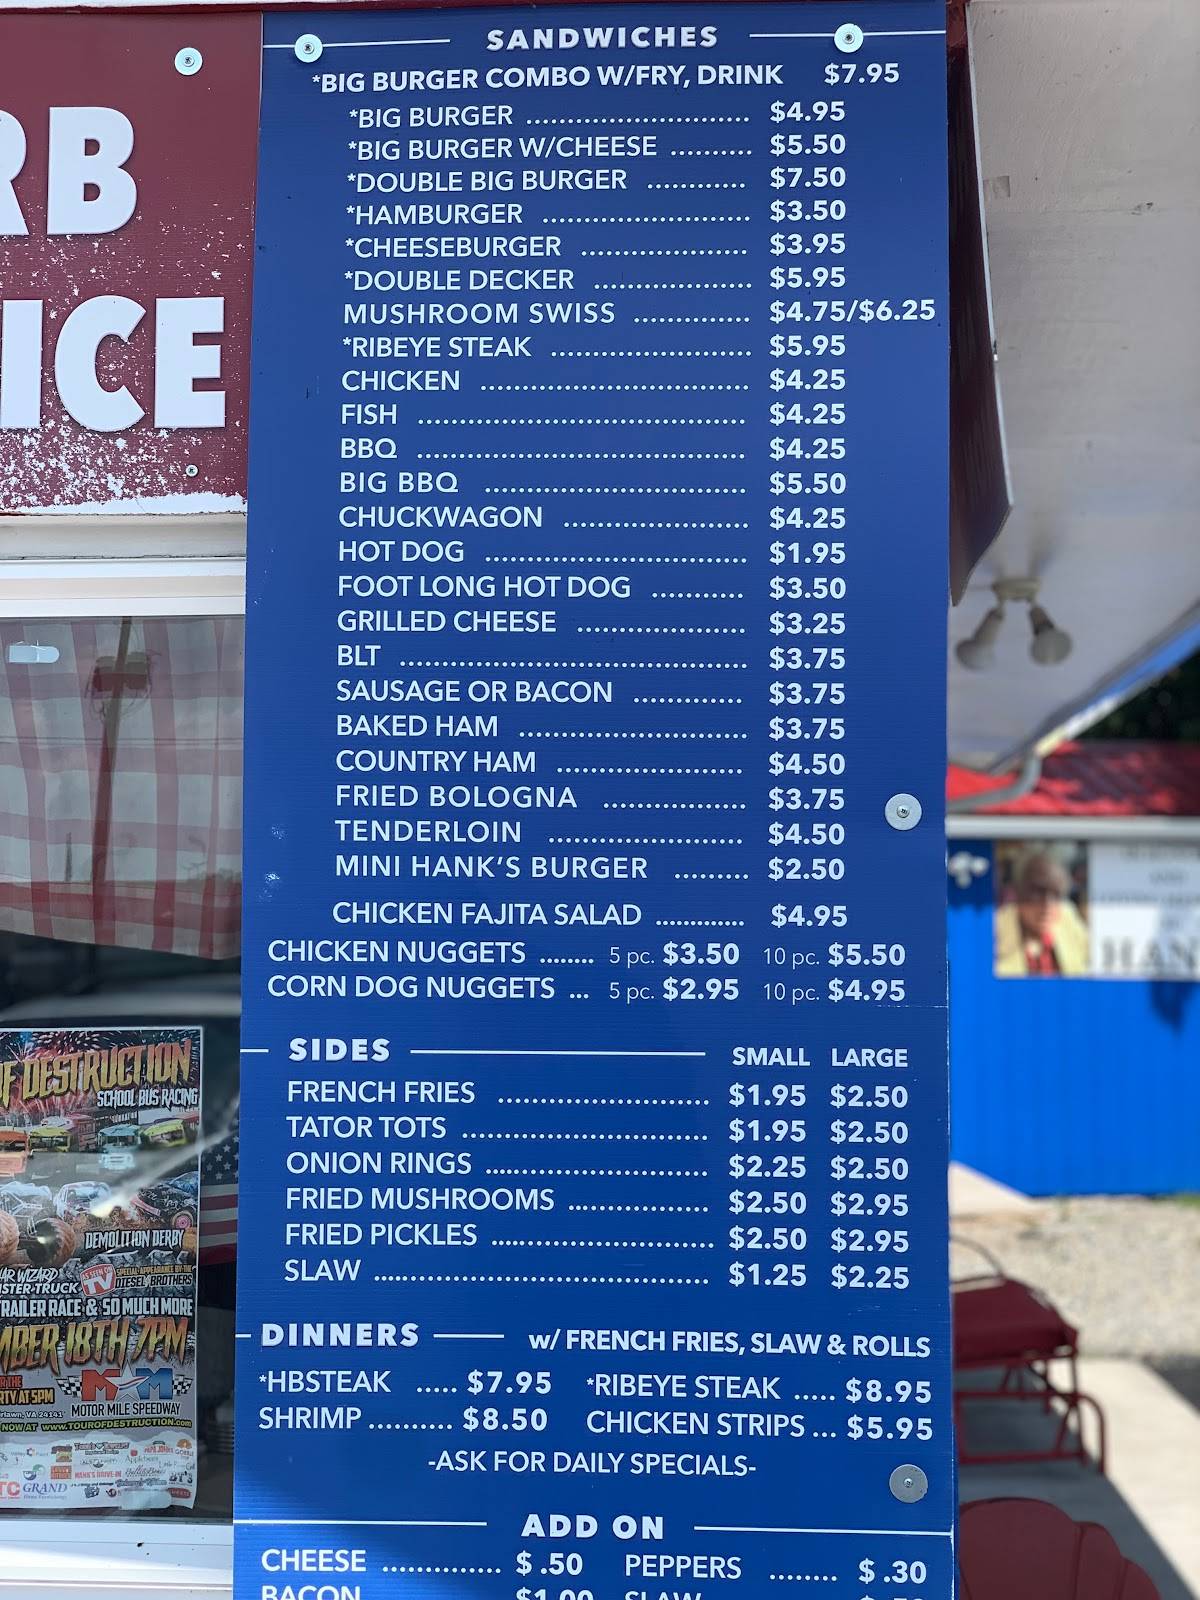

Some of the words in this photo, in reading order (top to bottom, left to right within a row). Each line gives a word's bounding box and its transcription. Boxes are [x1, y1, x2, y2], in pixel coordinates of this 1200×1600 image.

[487, 26, 717, 50] SANDWICHES
[373, 69, 478, 91] BURGER
[486, 66, 590, 88] COMBO
[597, 65, 690, 88] W/FRY,
[698, 65, 783, 84] DRINK
[824, 63, 899, 85] $7.95
[409, 138, 512, 159] BURGER
[519, 136, 657, 158] W/CHEESE
[770, 133, 845, 157] $5.50
[344, 303, 517, 324] MUSHROOM
[529, 302, 614, 323] SWISS
[770, 299, 935, 324] $4.75/$6.25
[0, 295, 225, 429] ICE
[342, 370, 459, 391] CHICKEN
[770, 368, 845, 392] $4.25
[341, 438, 397, 458] BBQ
[769, 437, 845, 461] $4.25
[339, 506, 542, 527] CHUCKWAGON
[770, 506, 845, 530] $4.25
[339, 576, 413, 597] FOOT
[420, 576, 495, 597] LONG
[505, 576, 561, 597] HOT
[568, 576, 630, 598] DOG
[770, 576, 846, 600] $3.50
[337, 680, 460, 702] SAUSAGE
[468, 681, 507, 702] OR
[516, 681, 612, 702] BACON
[769, 681, 845, 706] $3.75
[336, 855, 399, 876] MINI
[412, 856, 520, 878] HANK'S
[532, 857, 647, 878] BURGER
[768, 857, 844, 881] $2.50
[333, 902, 452, 924] CHICKEN
[462, 903, 548, 924] FAJITA
[554, 904, 641, 925] SALAD
[771, 904, 847, 928] $4.95
[268, 940, 388, 962] CHICKEN
[398, 941, 525, 963] NUGGETS
[610, 947, 620, 963] 5
[628, 952, 654, 968] pc.
[663, 941, 739, 966] $3.50
[764, 948, 785, 964] 10
[793, 953, 819, 969] pc.
[828, 942, 905, 967] $5.50
[268, 975, 346, 997] CORN
[356, 976, 417, 997] DOG
[427, 977, 554, 998] NUGGETS
[610, 982, 620, 999] 5
[627, 987, 654, 1004] pc.
[663, 976, 738, 1001] $2.95
[764, 983, 785, 1000] 10
[793, 988, 819, 1005] pc.
[828, 978, 905, 1002] $4.95
[289, 1038, 389, 1061] SIDES
[732, 1047, 810, 1066] SMALL
[832, 1048, 908, 1067] LARGE
[23, 1040, 191, 1100] DESTRUCTION
[97, 1089, 136, 1108] SCHOOL
[139, 1088, 159, 1106] BUS
[162, 1087, 198, 1110] RACING
[288, 1081, 395, 1102] FRENCH
[405, 1082, 475, 1103] FRIES
[729, 1082, 806, 1107] $1.95
[830, 1084, 908, 1108] $2.50
[286, 1116, 372, 1138] TATOR
[379, 1117, 446, 1138] TOTS
[729, 1118, 806, 1143] $1.95
[830, 1119, 908, 1144] $2.50
[287, 1152, 381, 1174] ONION
[391, 1152, 471, 1174] RINGS
[729, 1154, 806, 1179] $2.25
[831, 1155, 908, 1180] $2.50
[287, 1188, 363, 1209] FRIED
[372, 1188, 554, 1210] MUSHROOMS
[729, 1189, 806, 1214] $2.50
[831, 1191, 908, 1216] $2.95
[85, 1230, 150, 1249] DEMOLITION
[152, 1229, 184, 1248] DERBY
[17, 1267, 58, 1283] WIZARD
[83, 1273, 113, 1294] TV
[116, 1277, 145, 1288] DIESEL
[150, 1274, 192, 1286] BROTHERS
[285, 1259, 361, 1281] SLAW
[729, 1261, 806, 1287] $1.25
[831, 1264, 909, 1289] $2.25
[0, 1283, 31, 1295] STER
[35, 1282, 79, 1294] TRUCK
[0, 1299, 46, 1317] RAILER
[48, 1299, 81, 1316] RACE
[86, 1298, 98, 1316] &
[103, 1298, 120, 1315] SO
[122, 1298, 159, 1315] MUCH
[161, 1298, 193, 1315] MORE
[65, 1317, 129, 1368] 18TH
[134, 1316, 188, 1366] 7PM
[262, 1323, 418, 1346] DINNERS
[529, 1329, 561, 1350] w/
[567, 1330, 665, 1351] FRENCH
[673, 1331, 745, 1355] FRIES,
[751, 1333, 822, 1354] SLAW
[827, 1334, 846, 1355] &
[853, 1335, 930, 1357] ROLLS
[467, 1369, 551, 1395] $7.95
[695, 1376, 780, 1399] STEAK
[846, 1377, 931, 1403] $8.95
[72, 1404, 104, 1417] MOTOR
[108, 1403, 130, 1416] MILE
[133, 1402, 181, 1415] SPEEDWAY
[259, 1407, 361, 1429] SHRIMP
[463, 1406, 547, 1432] $8.50
[1, 1422, 24, 1431] NOW
[25, 1422, 38, 1431] AT
[42, 1417, 192, 1431] www.TOUROFDESTRUCTION.com
[587, 1411, 708, 1434] CHICKEN
[717, 1413, 804, 1437] STRIPS
[847, 1414, 932, 1440] $5.95
[429, 1451, 486, 1471] -ASK
[495, 1451, 545, 1472] FOR
[554, 1452, 624, 1473] DAILY
[630, 1453, 756, 1476] SPECIALS-
[23, 1483, 67, 1495] GRAND
[521, 1514, 597, 1537] ADD
[613, 1515, 663, 1539] ON
[261, 1549, 366, 1572] CHEESE
[626, 1555, 741, 1579] PEPPERS
[262, 1585, 360, 1600] BACON
